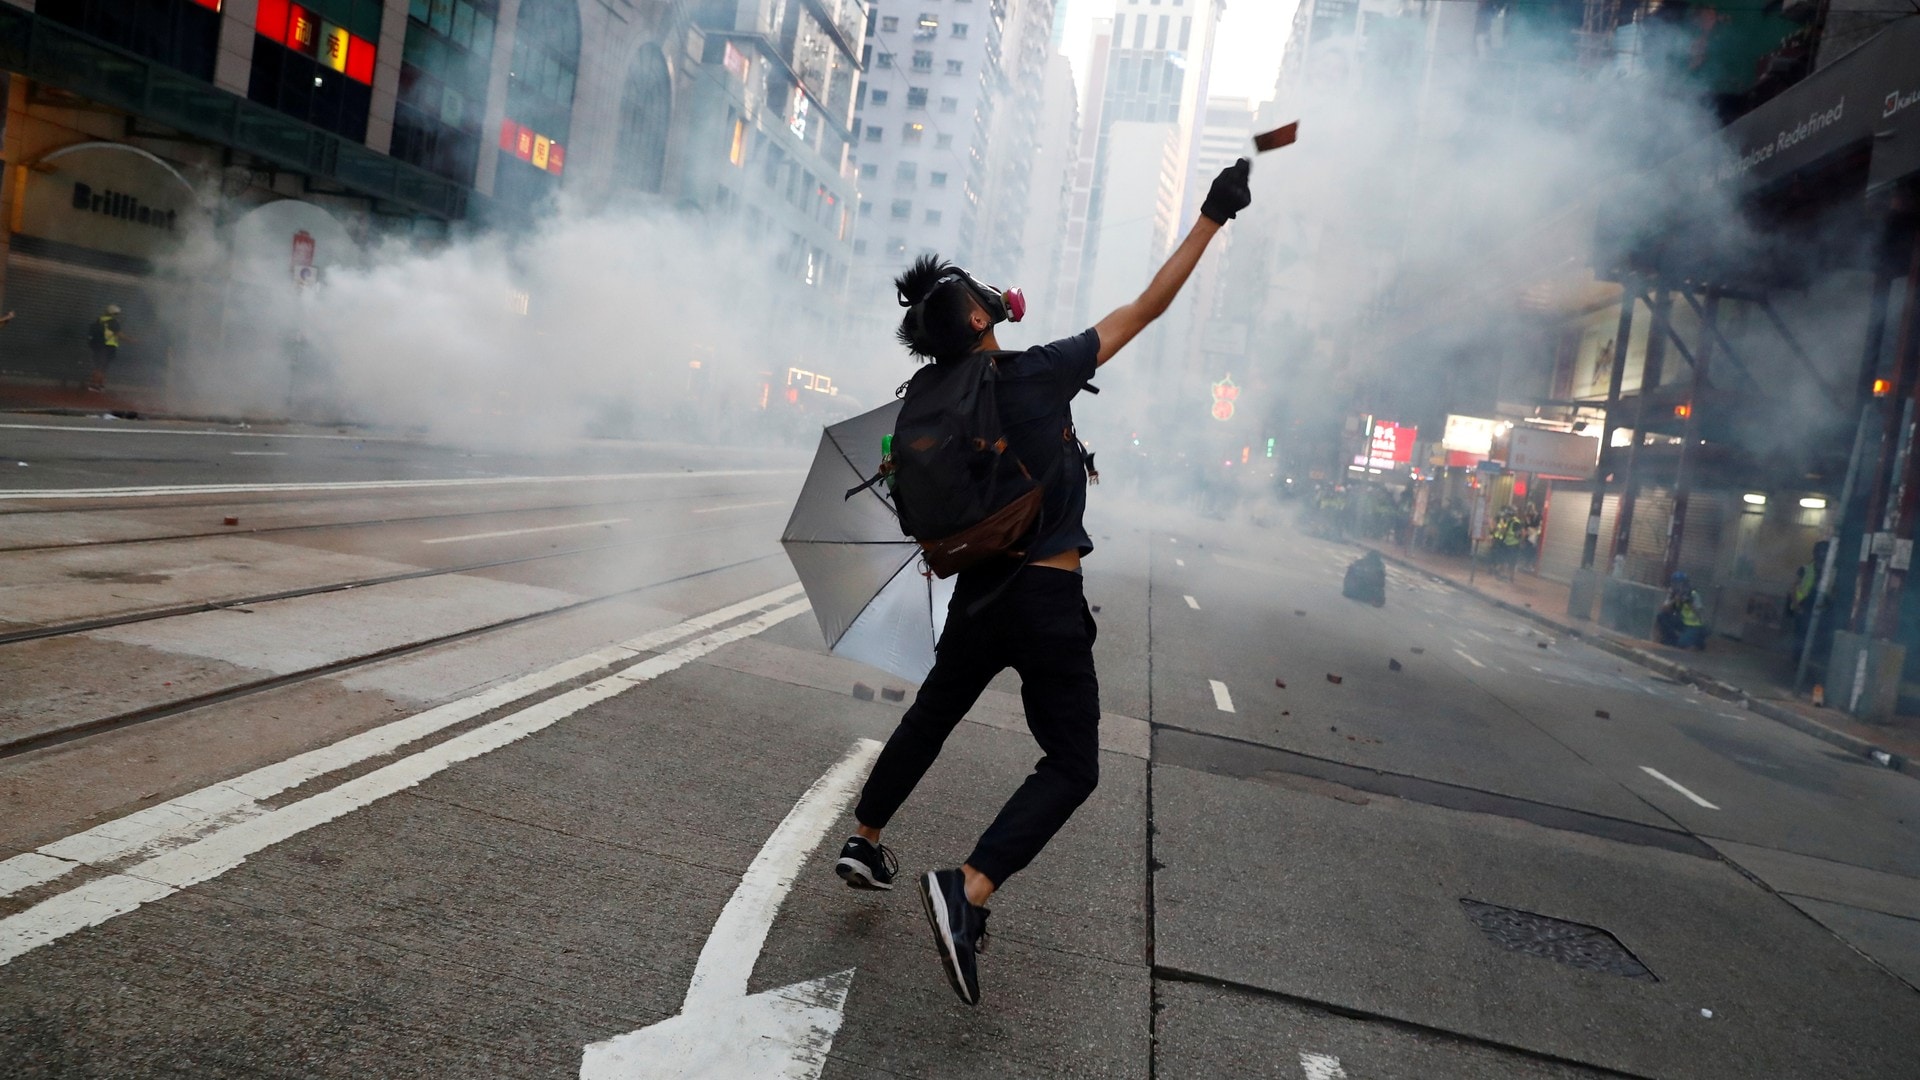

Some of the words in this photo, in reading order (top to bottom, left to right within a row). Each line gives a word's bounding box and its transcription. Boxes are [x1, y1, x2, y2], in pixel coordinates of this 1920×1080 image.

[295, 17, 341, 59] 利苑
[1775, 97, 1845, 154] Redefined
[72, 181, 177, 233] Brilliant
